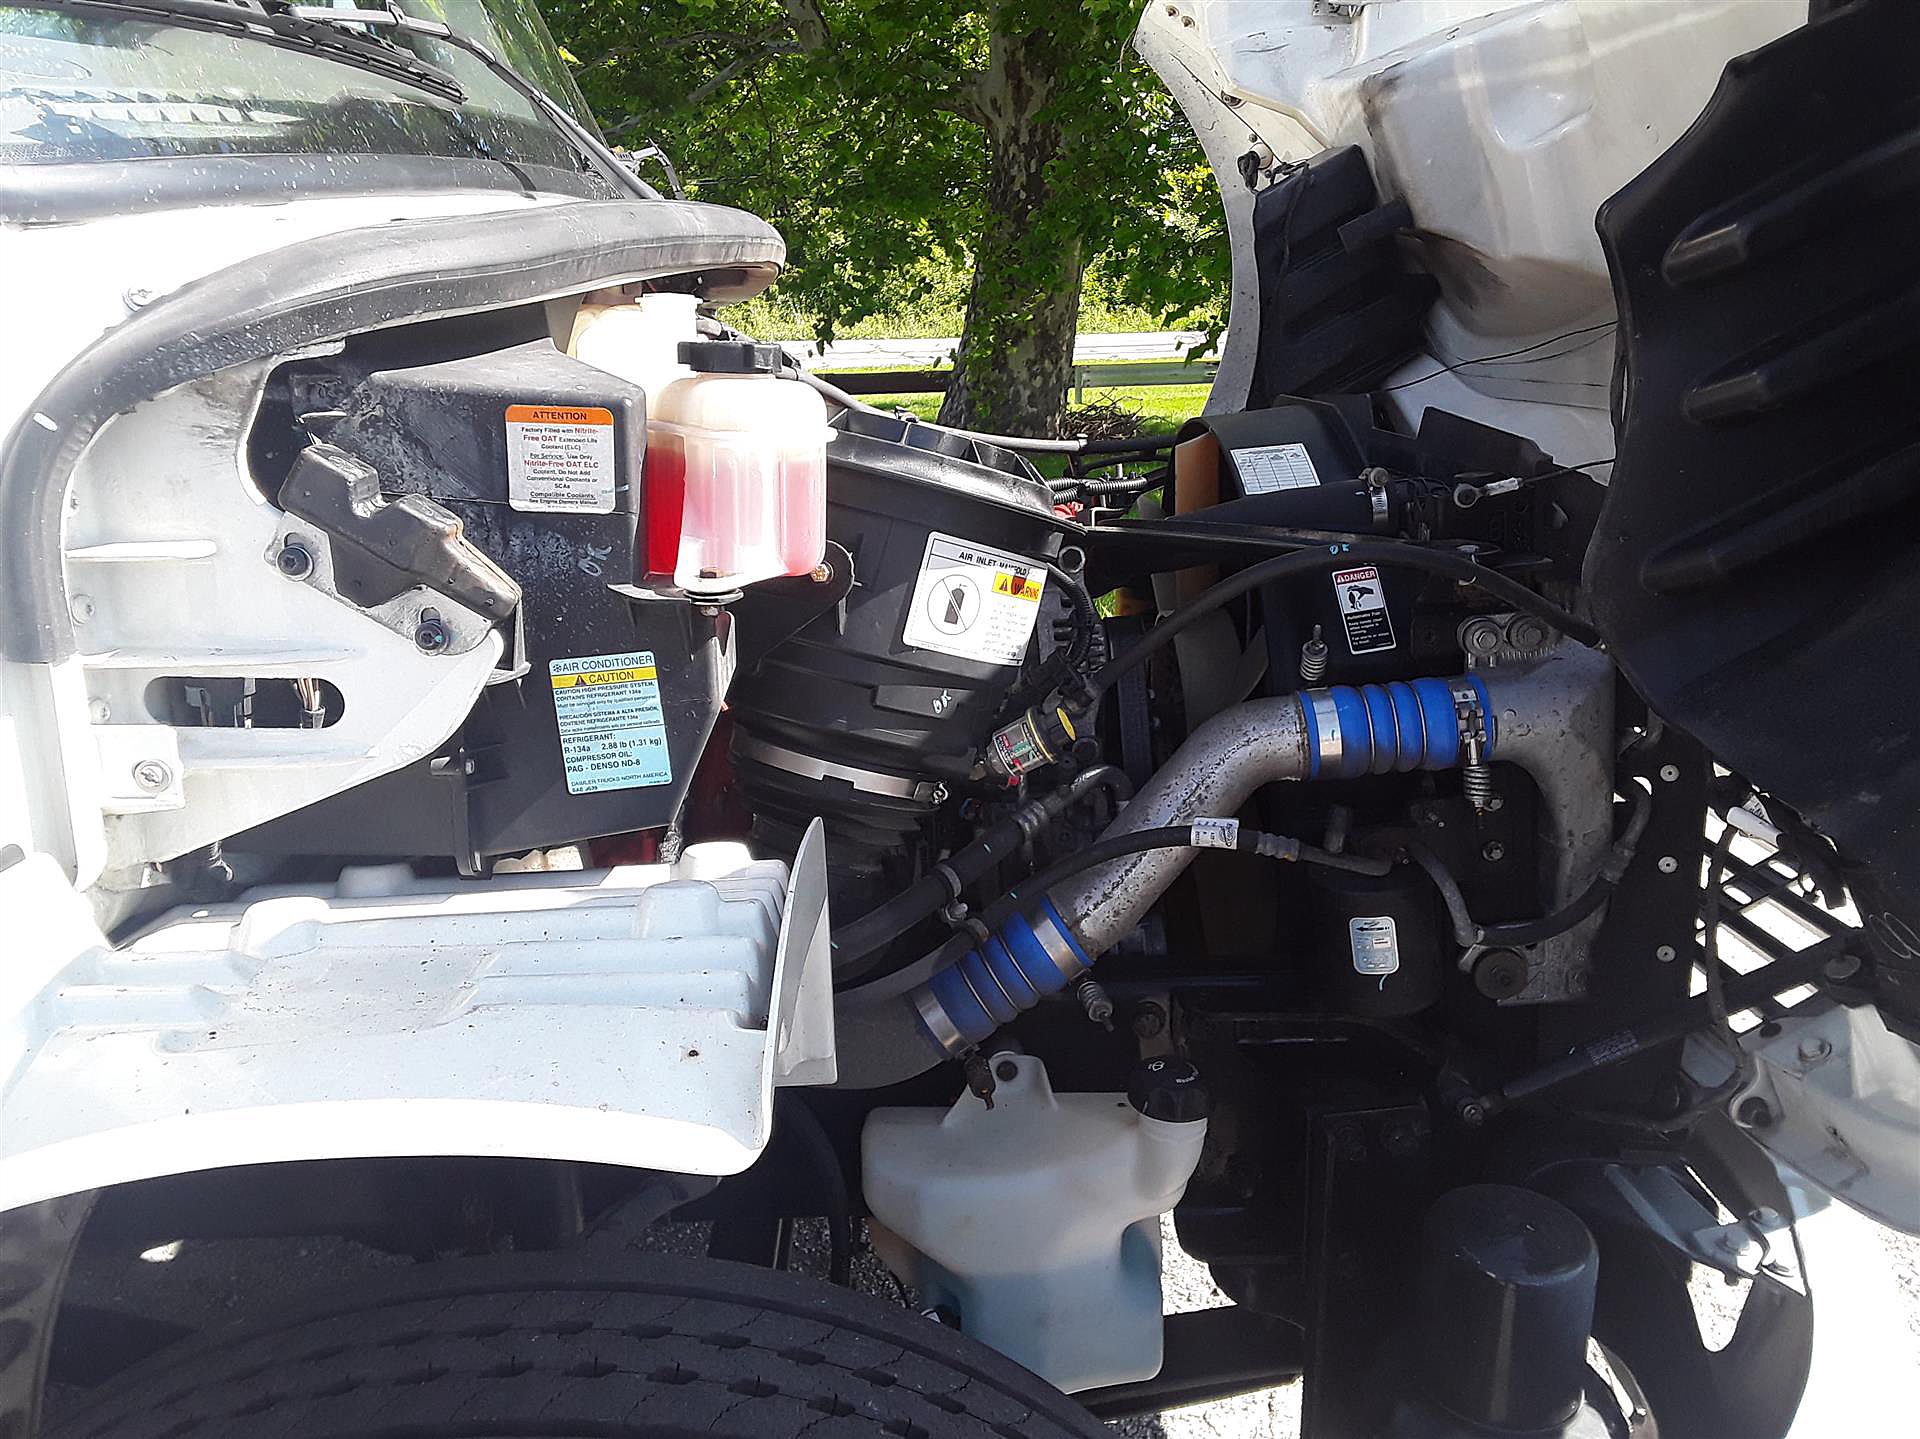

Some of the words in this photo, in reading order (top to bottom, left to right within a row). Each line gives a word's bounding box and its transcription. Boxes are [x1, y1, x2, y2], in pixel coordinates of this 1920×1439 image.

[533, 412, 586, 420] ATTENTION
[958, 551, 974, 562] AIR
[976, 555, 997, 566] INLET
[1344, 570, 1376, 582] DANGER
[562, 663, 580, 672] AIR
[582, 655, 652, 670] CONDITIONER
[588, 671, 634, 684] CAUTION
[562, 733, 616, 744] REFRIGERANT:
[564, 745, 591, 754] R-134a
[601, 742, 618, 750] 2.88
[628, 738, 648, 748] (1.31
[649, 737, 662, 746] kg)
[566, 752, 616, 764] COMPRESSOR
[567, 765, 584, 773] PAG
[590, 761, 619, 770] DENSO
[622, 758, 640, 768] ND-8
[598, 776, 620, 784] TRUCKS
